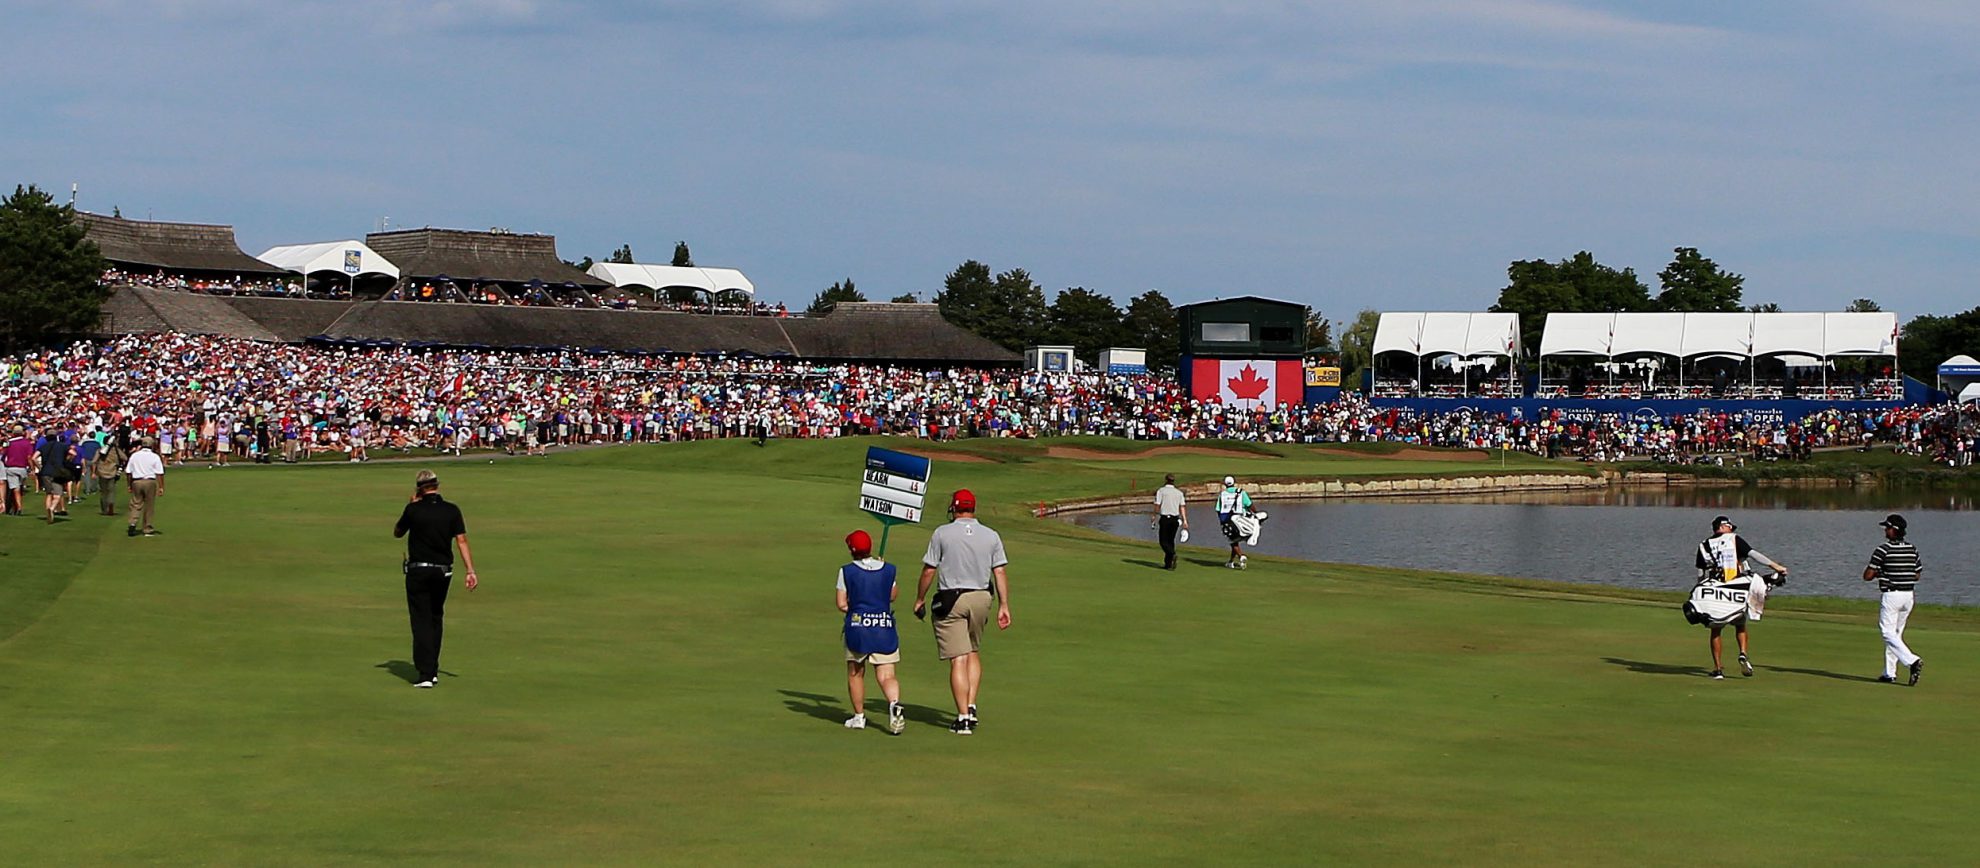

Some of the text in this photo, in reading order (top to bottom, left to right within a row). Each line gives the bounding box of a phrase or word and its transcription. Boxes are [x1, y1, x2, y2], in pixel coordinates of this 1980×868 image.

[1754, 414, 1783, 422] OPEN
[863, 497, 893, 515] WATSON
[1701, 588, 1746, 603] PING
[863, 618, 892, 628] OPEN
